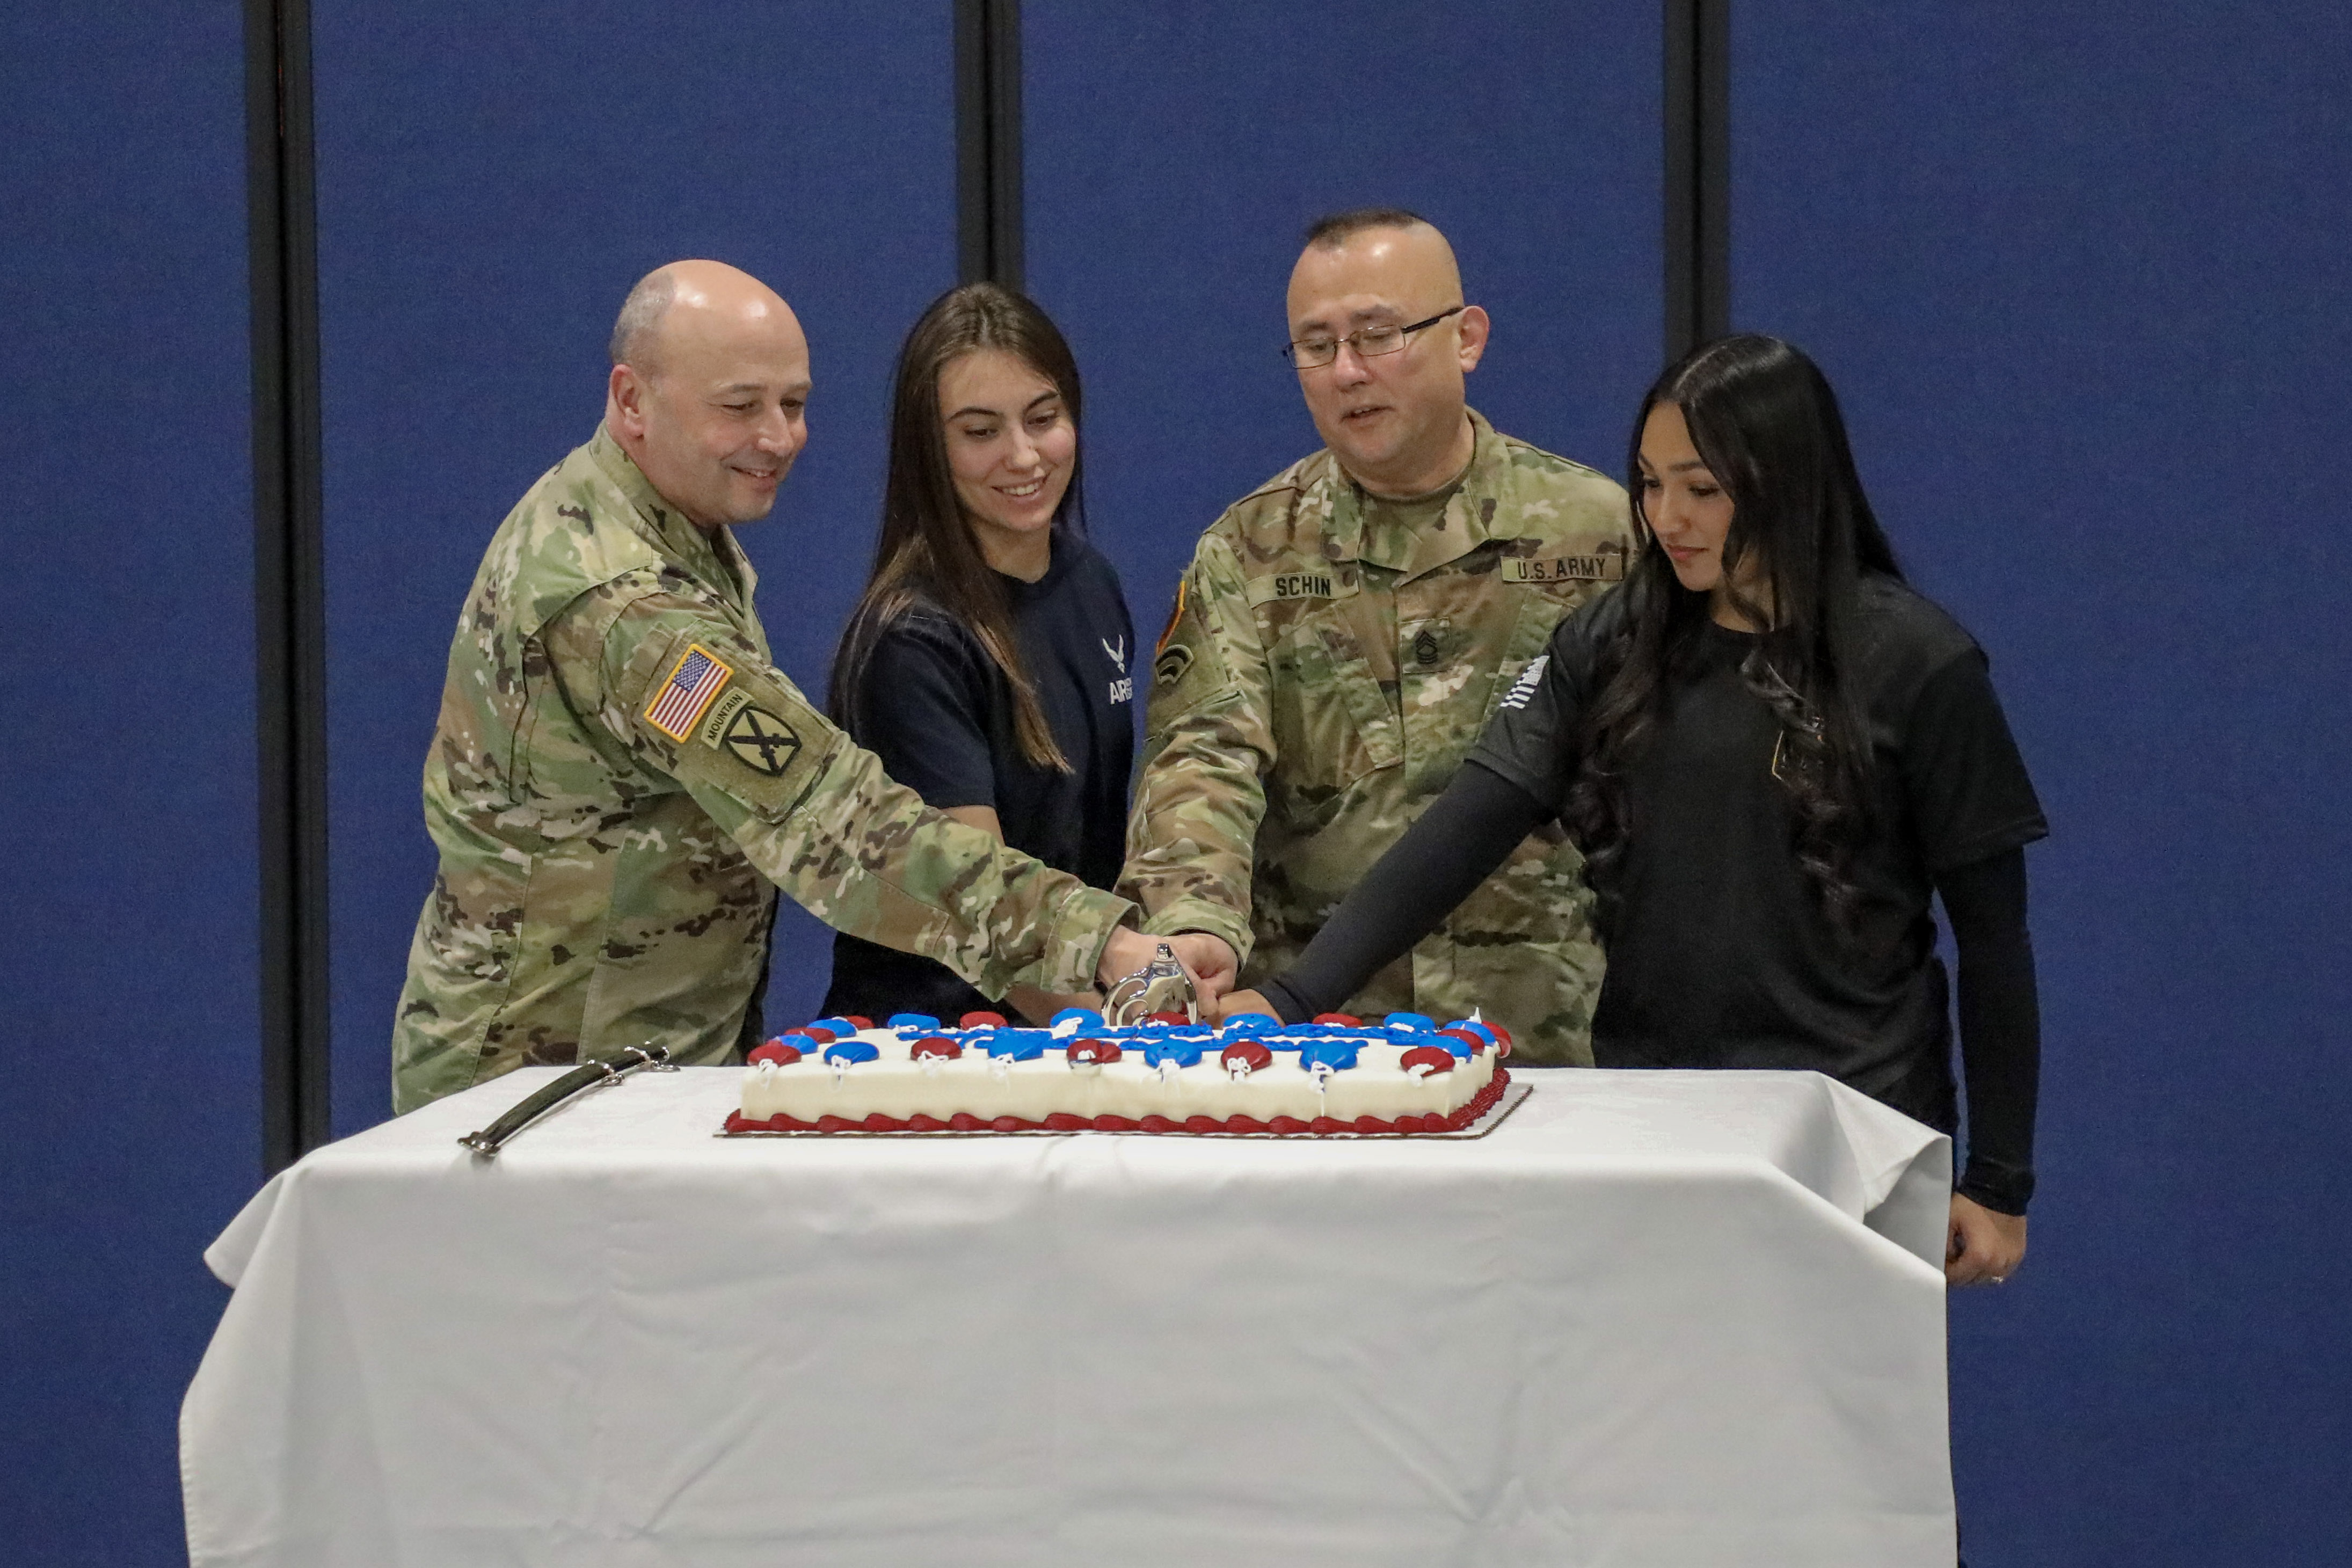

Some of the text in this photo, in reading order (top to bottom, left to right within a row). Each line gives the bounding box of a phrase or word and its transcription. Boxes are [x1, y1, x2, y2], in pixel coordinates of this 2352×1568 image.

[1518, 558, 1605, 579] U.S. ARMY
[1275, 576, 1331, 596] SCHIN
[708, 693, 743, 741] MOUNTAIN
